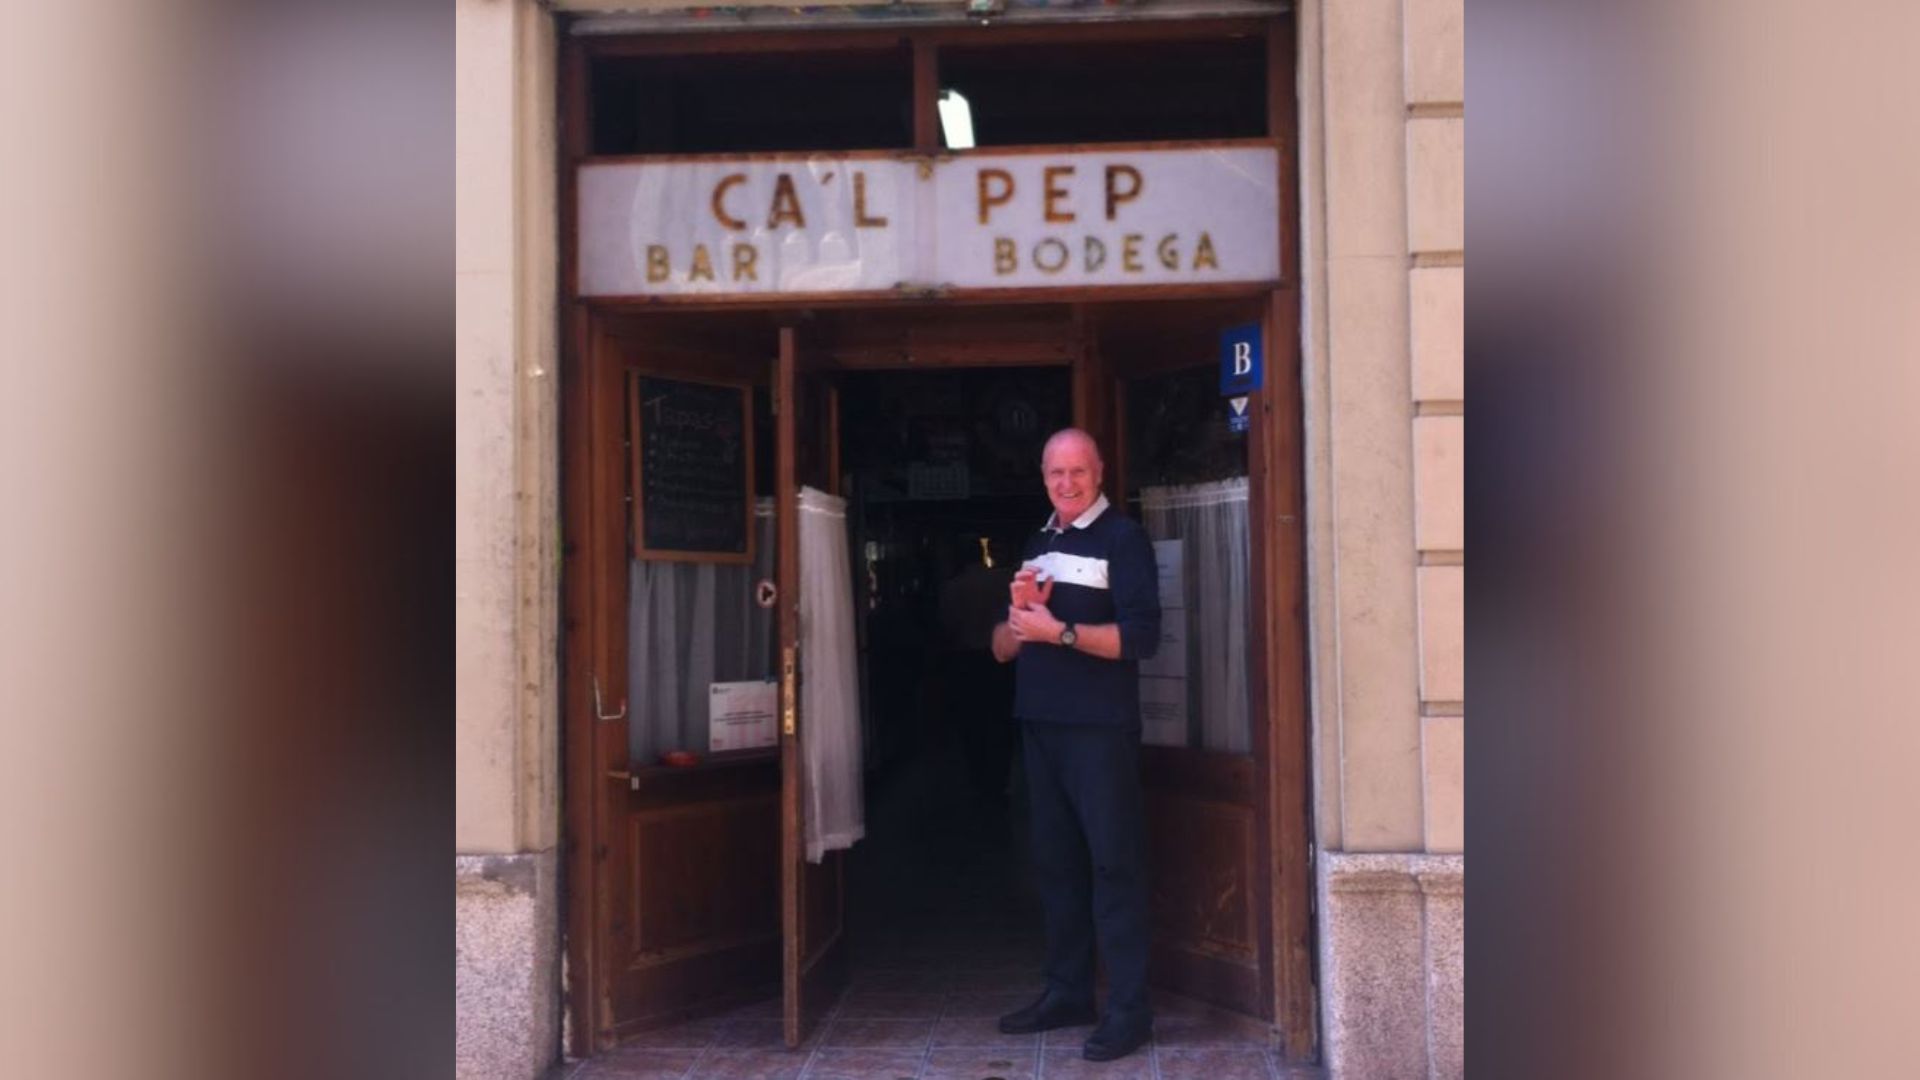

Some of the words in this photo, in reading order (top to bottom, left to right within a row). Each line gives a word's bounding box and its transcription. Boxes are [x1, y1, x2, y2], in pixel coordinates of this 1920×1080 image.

[977, 164, 1142, 225] PEP
[646, 243, 758, 283] BAR
[993, 230, 1218, 275] BODEGA
[1233, 341, 1252, 376] B
